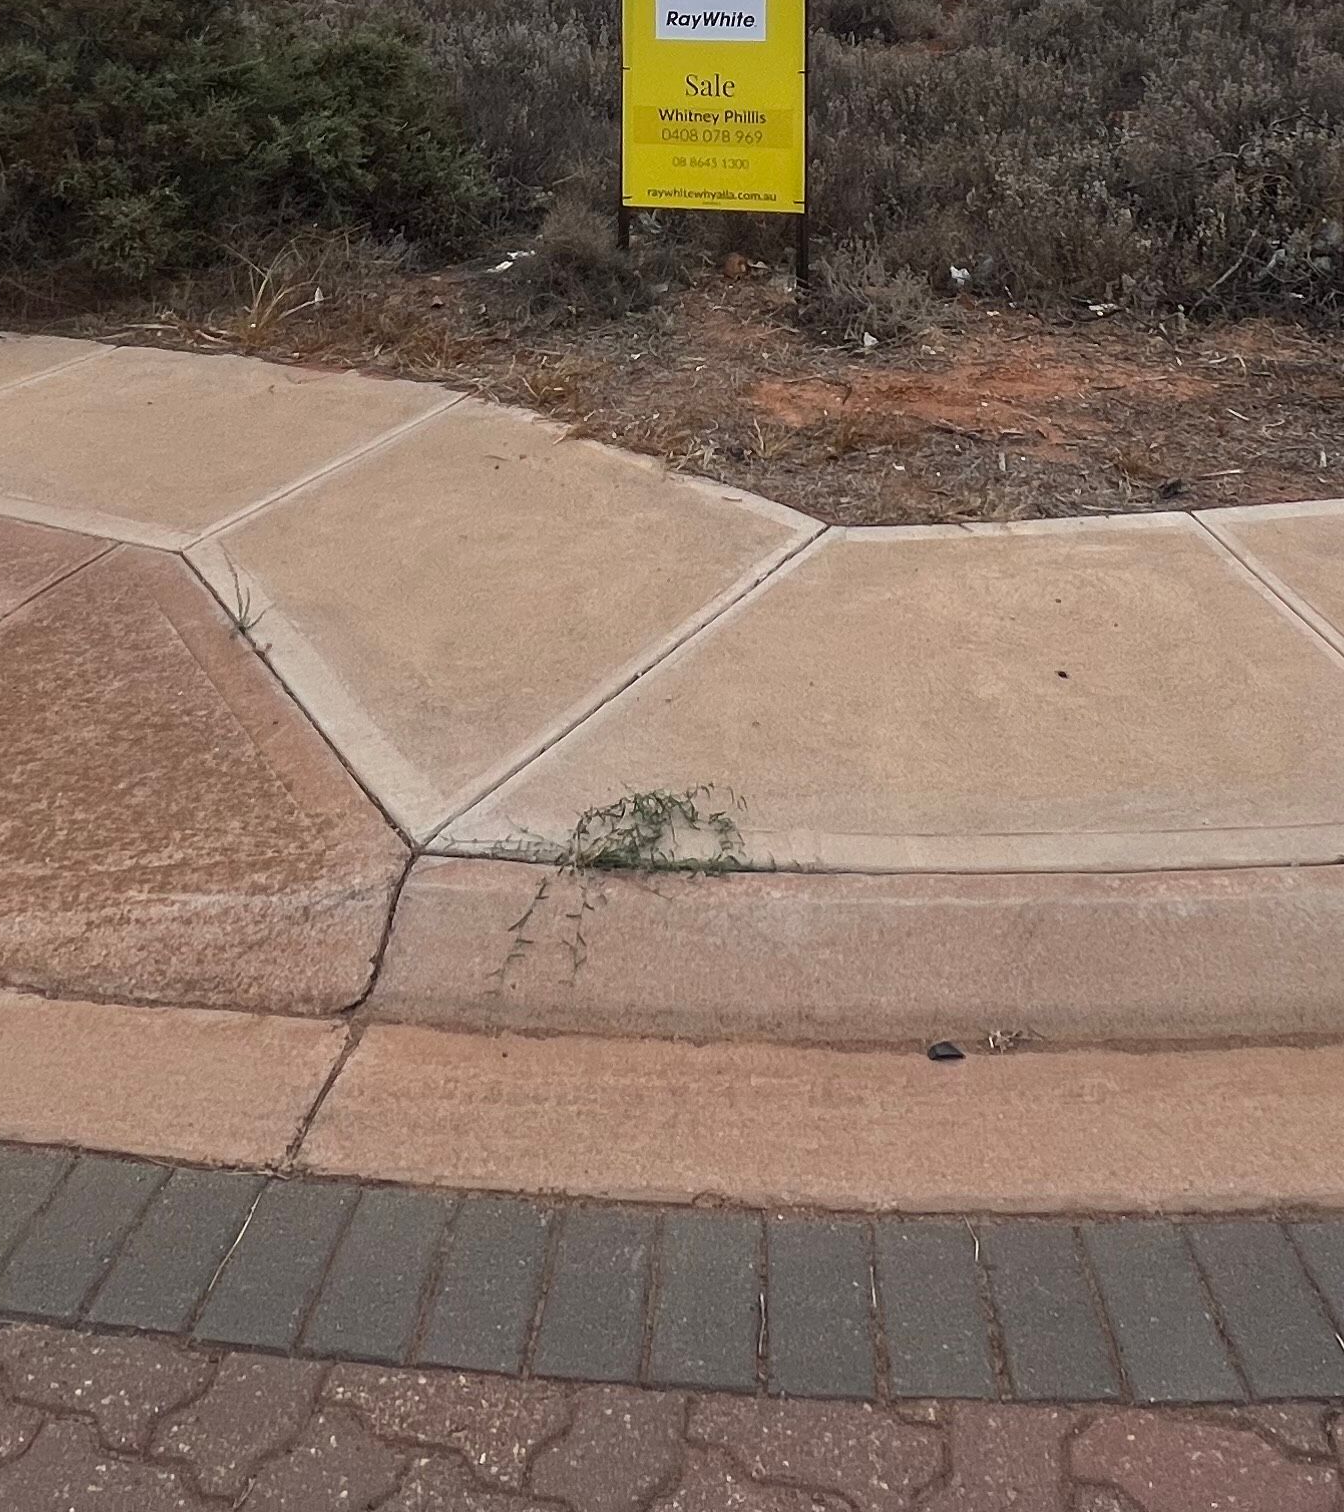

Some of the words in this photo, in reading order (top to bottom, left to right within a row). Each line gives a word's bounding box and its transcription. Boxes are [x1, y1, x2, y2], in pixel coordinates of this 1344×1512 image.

[685, 73, 735, 97] Sale
[659, 108, 720, 125] Whitney
[724, 109, 767, 124] Phillis
[661, 128, 698, 143] 0408
[702, 129, 731, 143] 078
[735, 130, 763, 144] 969
[672, 156, 687, 168] 08
[647, 188, 777, 201] raywhitewhyalla.com.au
